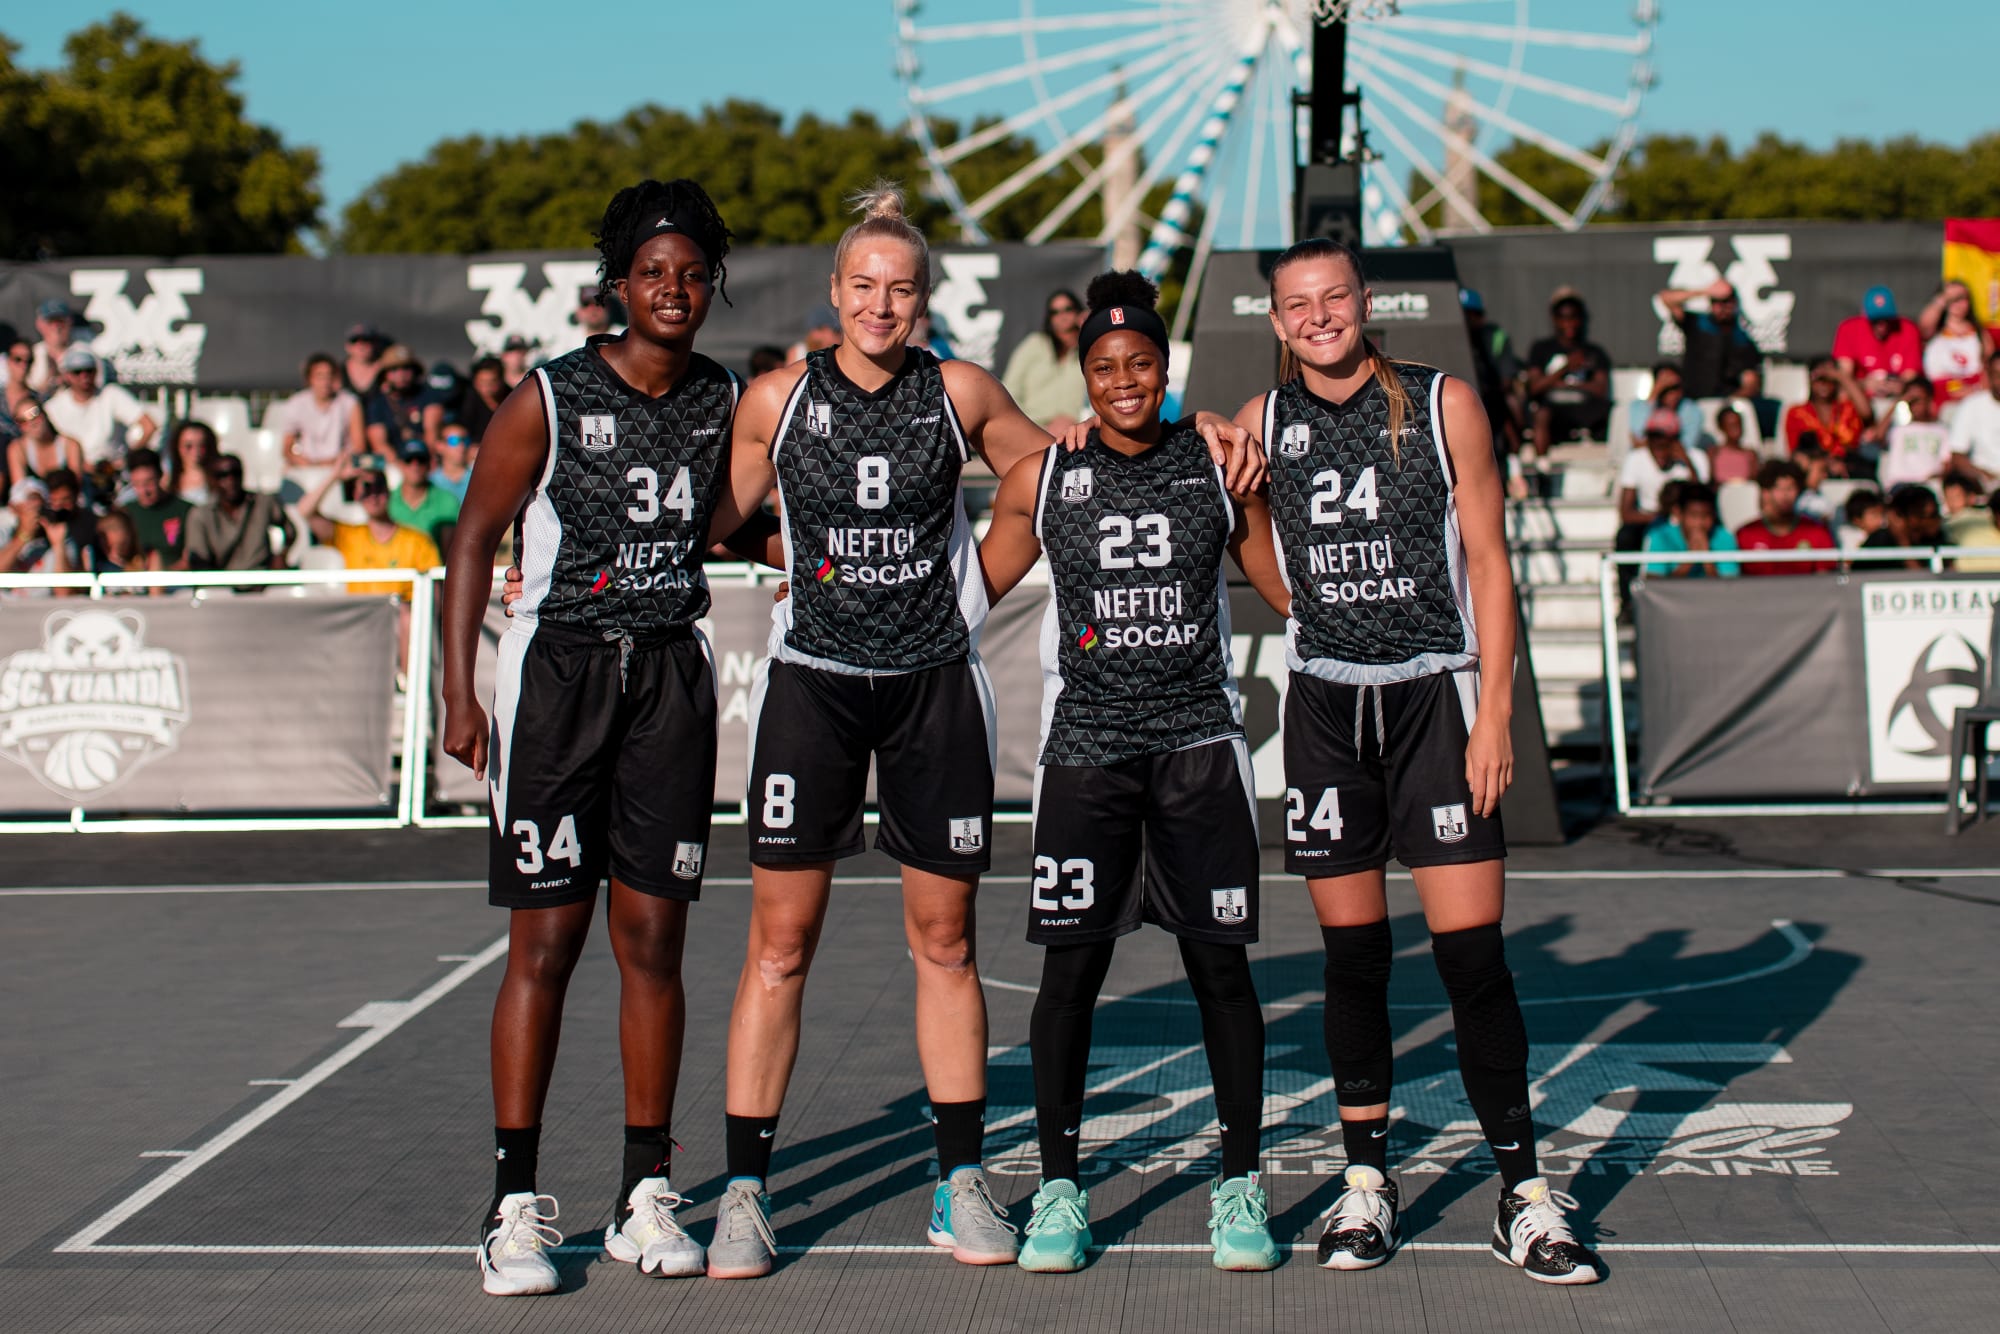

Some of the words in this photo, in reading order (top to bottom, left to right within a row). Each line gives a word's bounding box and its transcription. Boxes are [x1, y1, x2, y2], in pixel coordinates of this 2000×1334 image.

[627, 466, 695, 523] 34
[856, 456, 890, 509] 8
[1311, 466, 1379, 524] 24
[1099, 513, 1172, 569] 23
[615, 569, 692, 591] SOCAR
[840, 559, 933, 585] SOCAR
[1320, 577, 1418, 603] SOCAR
[1105, 624, 1200, 648] SOCAR
[762, 773, 796, 829] 8
[1285, 787, 1344, 841] 24
[513, 814, 582, 874] 34
[1033, 854, 1095, 911] 23
